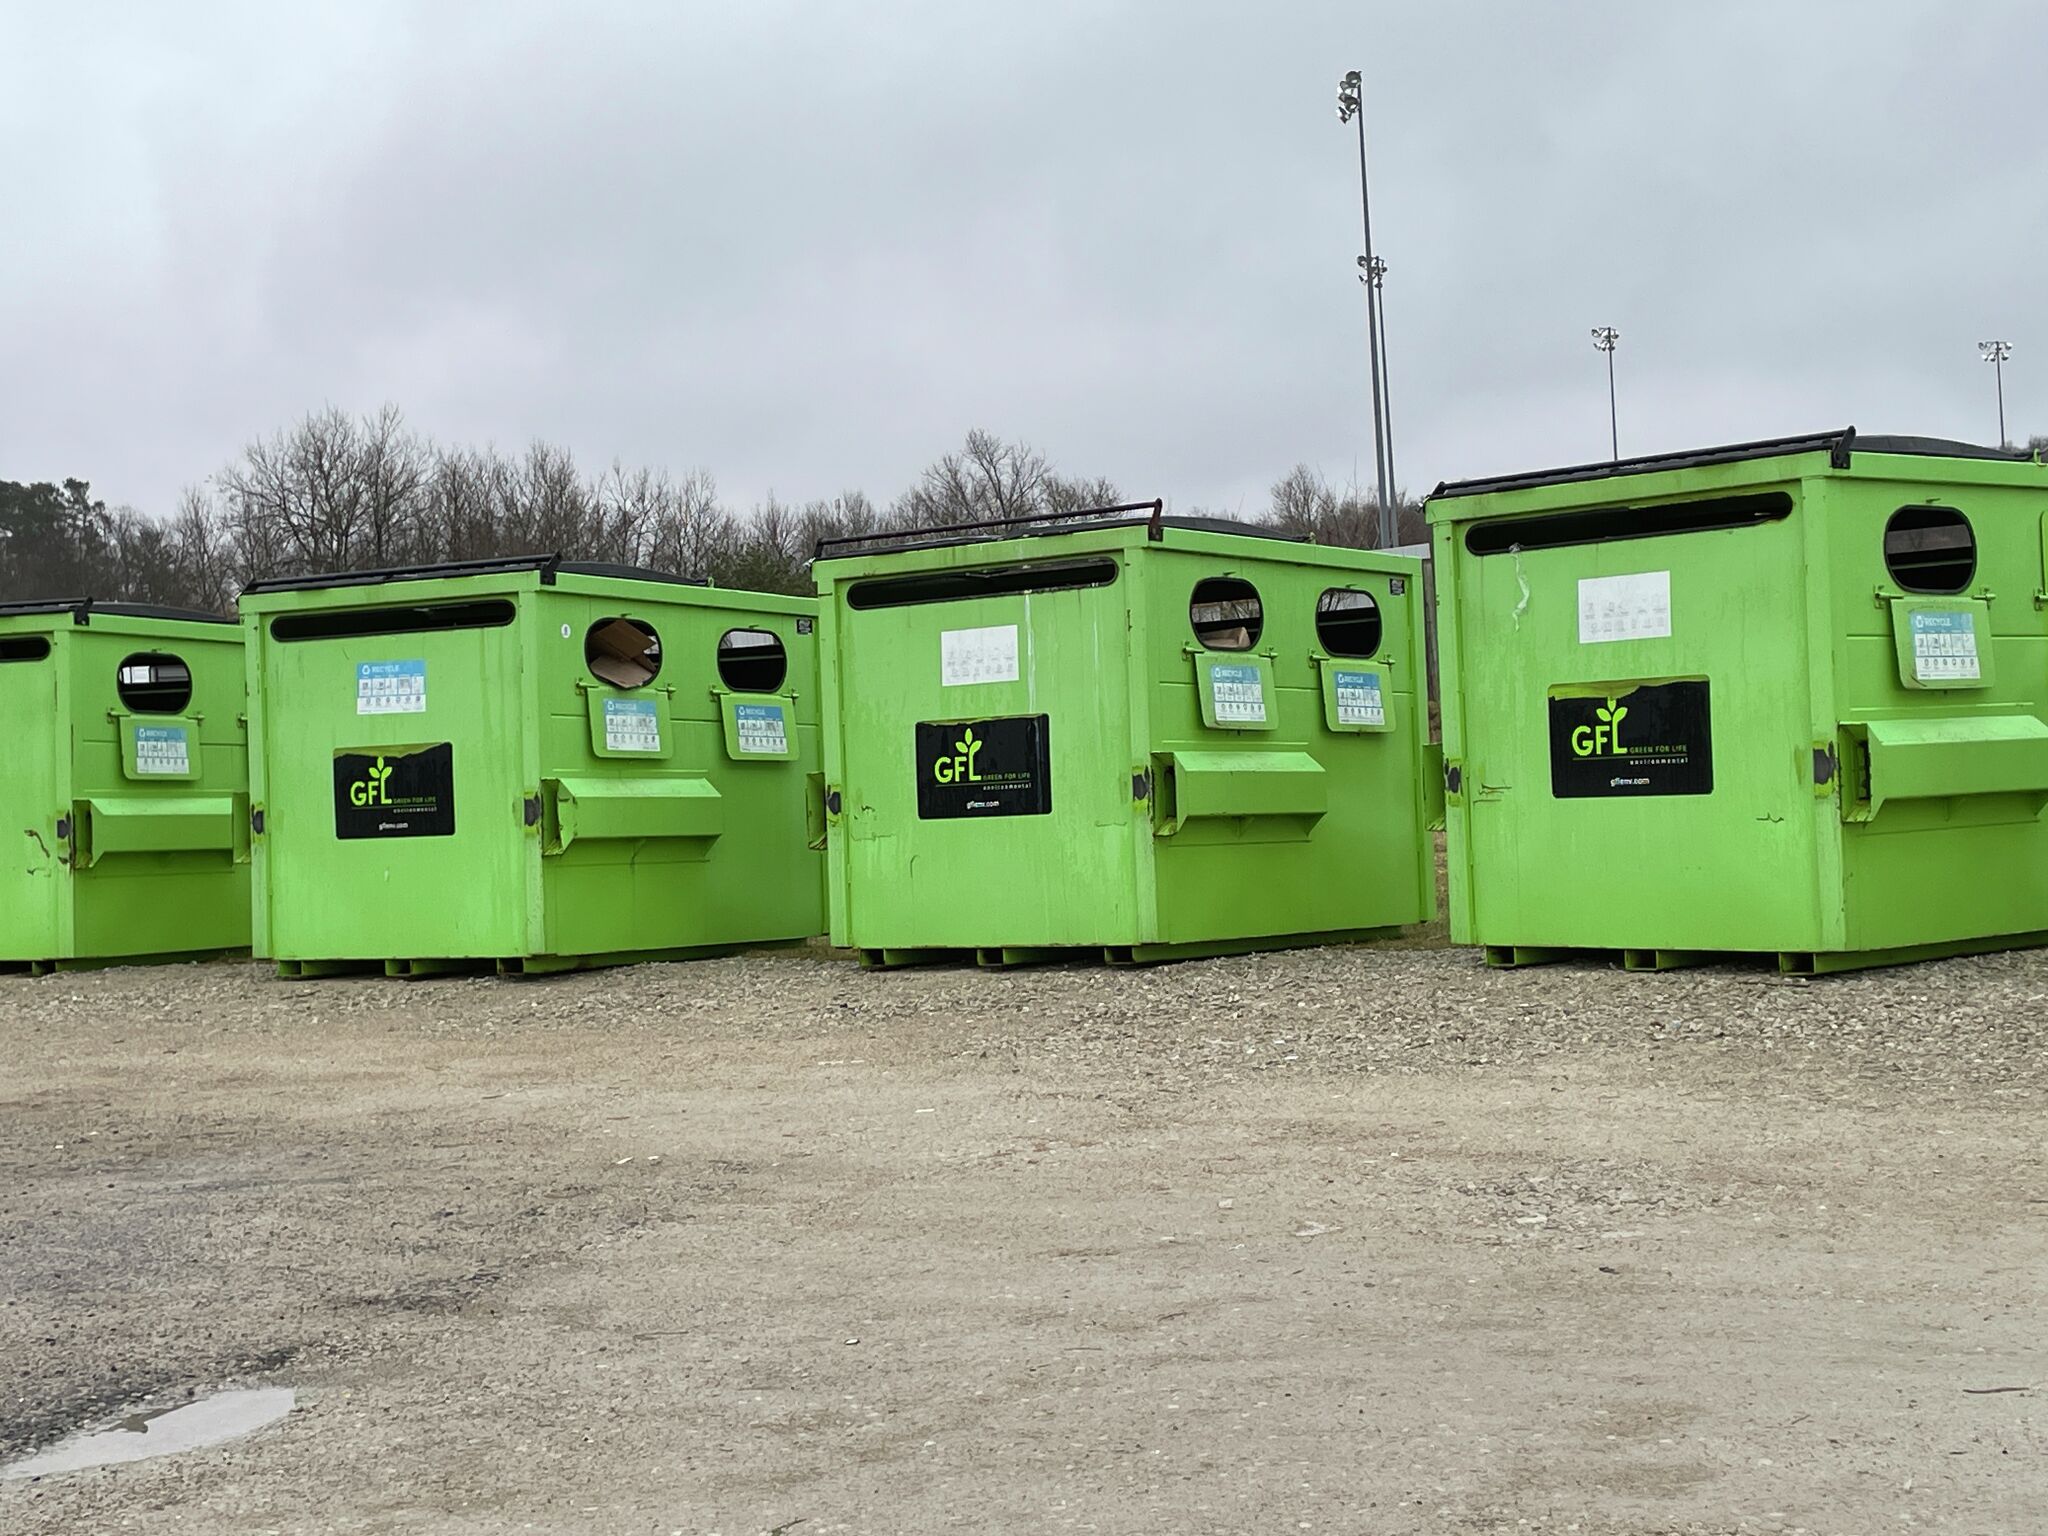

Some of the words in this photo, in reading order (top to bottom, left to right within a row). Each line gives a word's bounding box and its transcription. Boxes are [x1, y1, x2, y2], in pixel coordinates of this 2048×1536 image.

[1572, 707, 1628, 756] GFL
[1629, 745, 1653, 754] GREEN
[1655, 745, 1669, 753] FOR
[1671, 744, 1688, 753] LIFE
[935, 740, 982, 783] GFL
[1629, 757, 1689, 766] environmental
[350, 767, 392, 806] GFL
